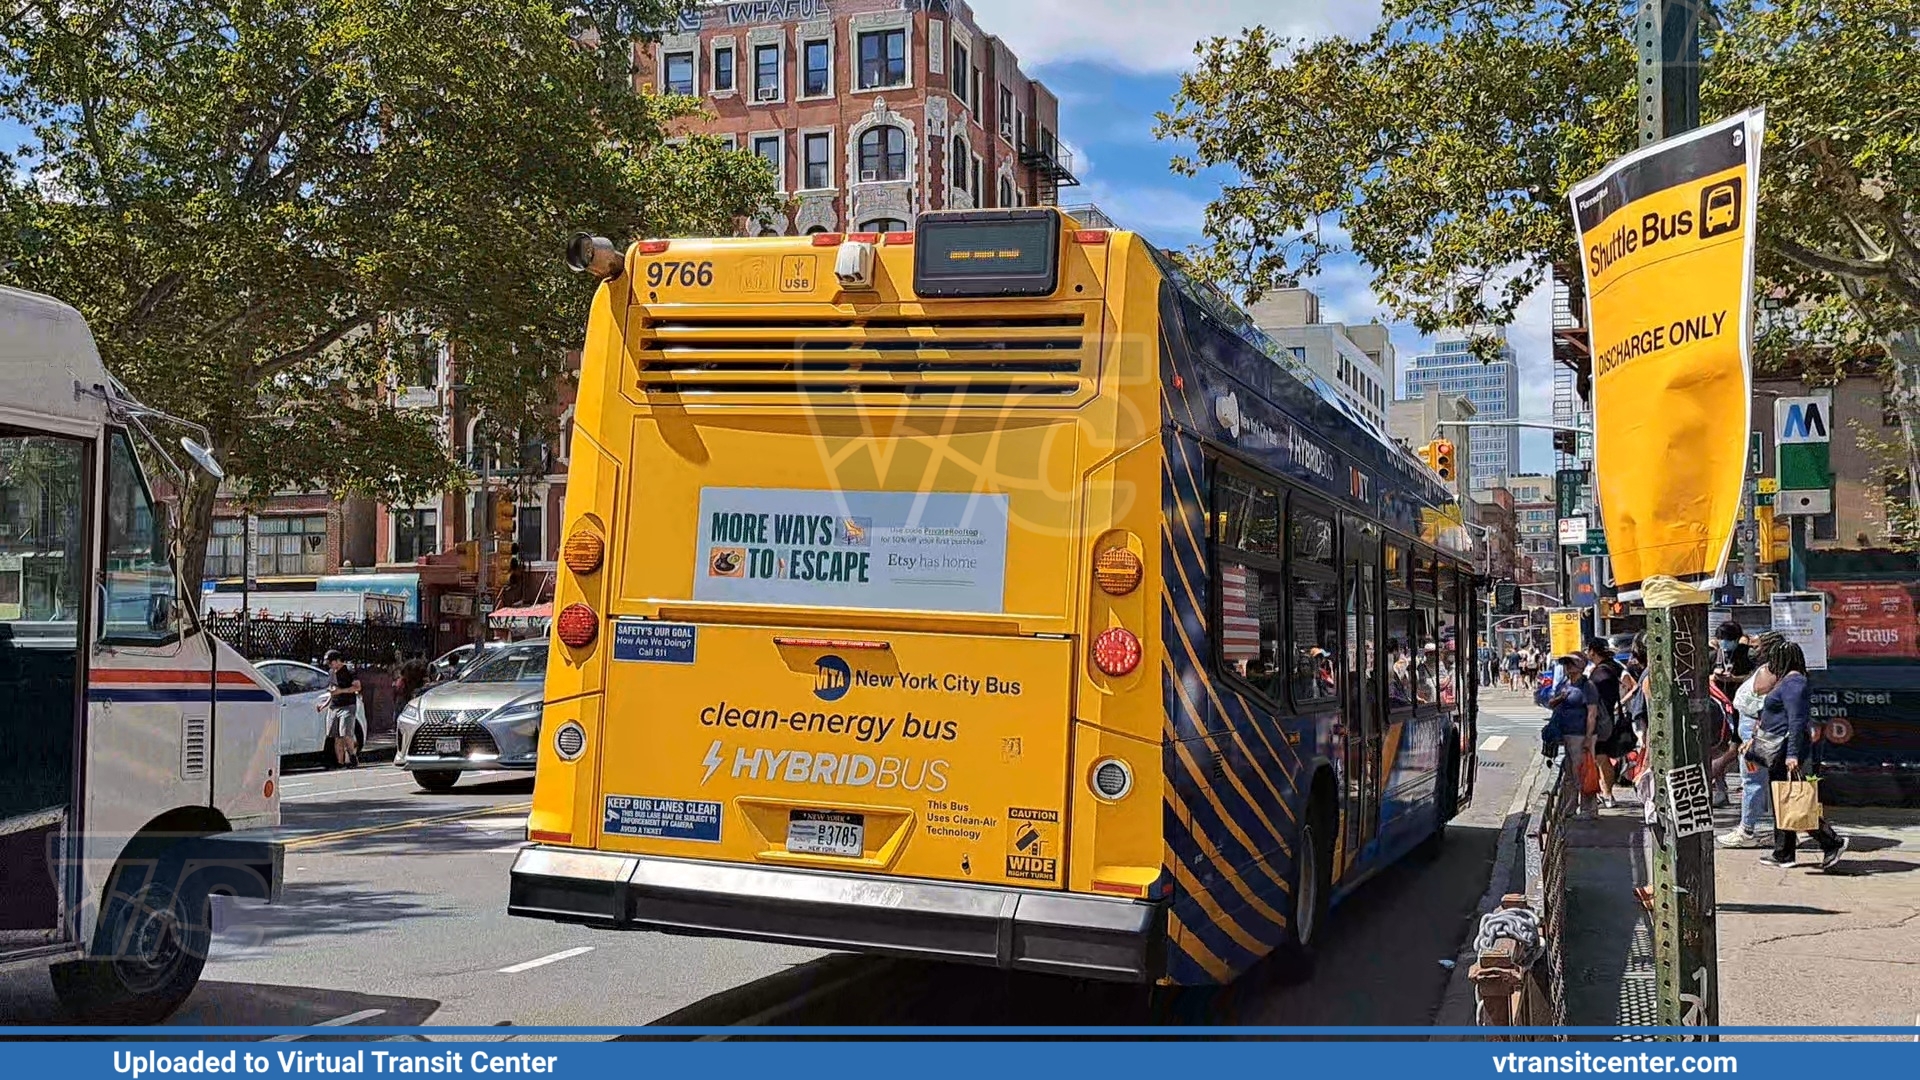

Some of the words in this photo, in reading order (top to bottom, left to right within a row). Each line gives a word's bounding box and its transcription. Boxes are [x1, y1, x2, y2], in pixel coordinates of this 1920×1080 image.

[1590, 224, 1638, 277] Shuttle
[1642, 210, 1693, 248] Bus
[647, 260, 713, 287] 9766
[785, 278, 809, 289] USB
[1598, 326, 1665, 377] DISCHARGE
[1669, 310, 1727, 346] ONLY
[711, 512, 769, 544] MORE
[773, 514, 833, 546] WAYS
[748, 548, 774, 579] TO
[790, 550, 870, 583] ESCAPE
[888, 553, 917, 569] Etsy
[919, 554, 940, 568] has
[942, 554, 977, 569] home
[617, 625, 653, 636] SAFETY'S
[654, 626, 670, 637] OUR
[672, 628, 692, 638] GOAL
[1846, 626, 1899, 646] Strays
[616, 636, 634, 645] How
[635, 637, 649, 646] Are
[650, 638, 663, 646] We
[664, 638, 691, 649] Doing?
[638, 647, 654, 656] Call
[655, 648, 667, 657] 511
[815, 664, 846, 691] MTA
[855, 669, 894, 688] New
[899, 672, 937, 690] York
[943, 674, 979, 696] City
[986, 677, 1021, 695] Bus
[1844, 691, 1891, 705] Street
[700, 701, 895, 743] clean-energy
[902, 712, 958, 740] bus
[731, 747, 950, 792] HYBRIDBUS
[607, 797, 631, 808] KEEP
[633, 799, 652, 811] BUS
[654, 800, 684, 813] LANES
[686, 803, 717, 816] CLEAR
[928, 800, 947, 810] This
[950, 801, 969, 811] Bus
[1670, 770, 1693, 834] RISOTE
[1686, 765, 1713, 830] RISOTE
[927, 812, 950, 823] Uses
[952, 814, 997, 827] Clean-Air
[1010, 808, 1056, 820] CAUTION
[826, 825, 858, 848] 3785
[926, 825, 981, 840] Technology
[1008, 856, 1054, 873] WIDE
[1030, 872, 1053, 880] TURNS
